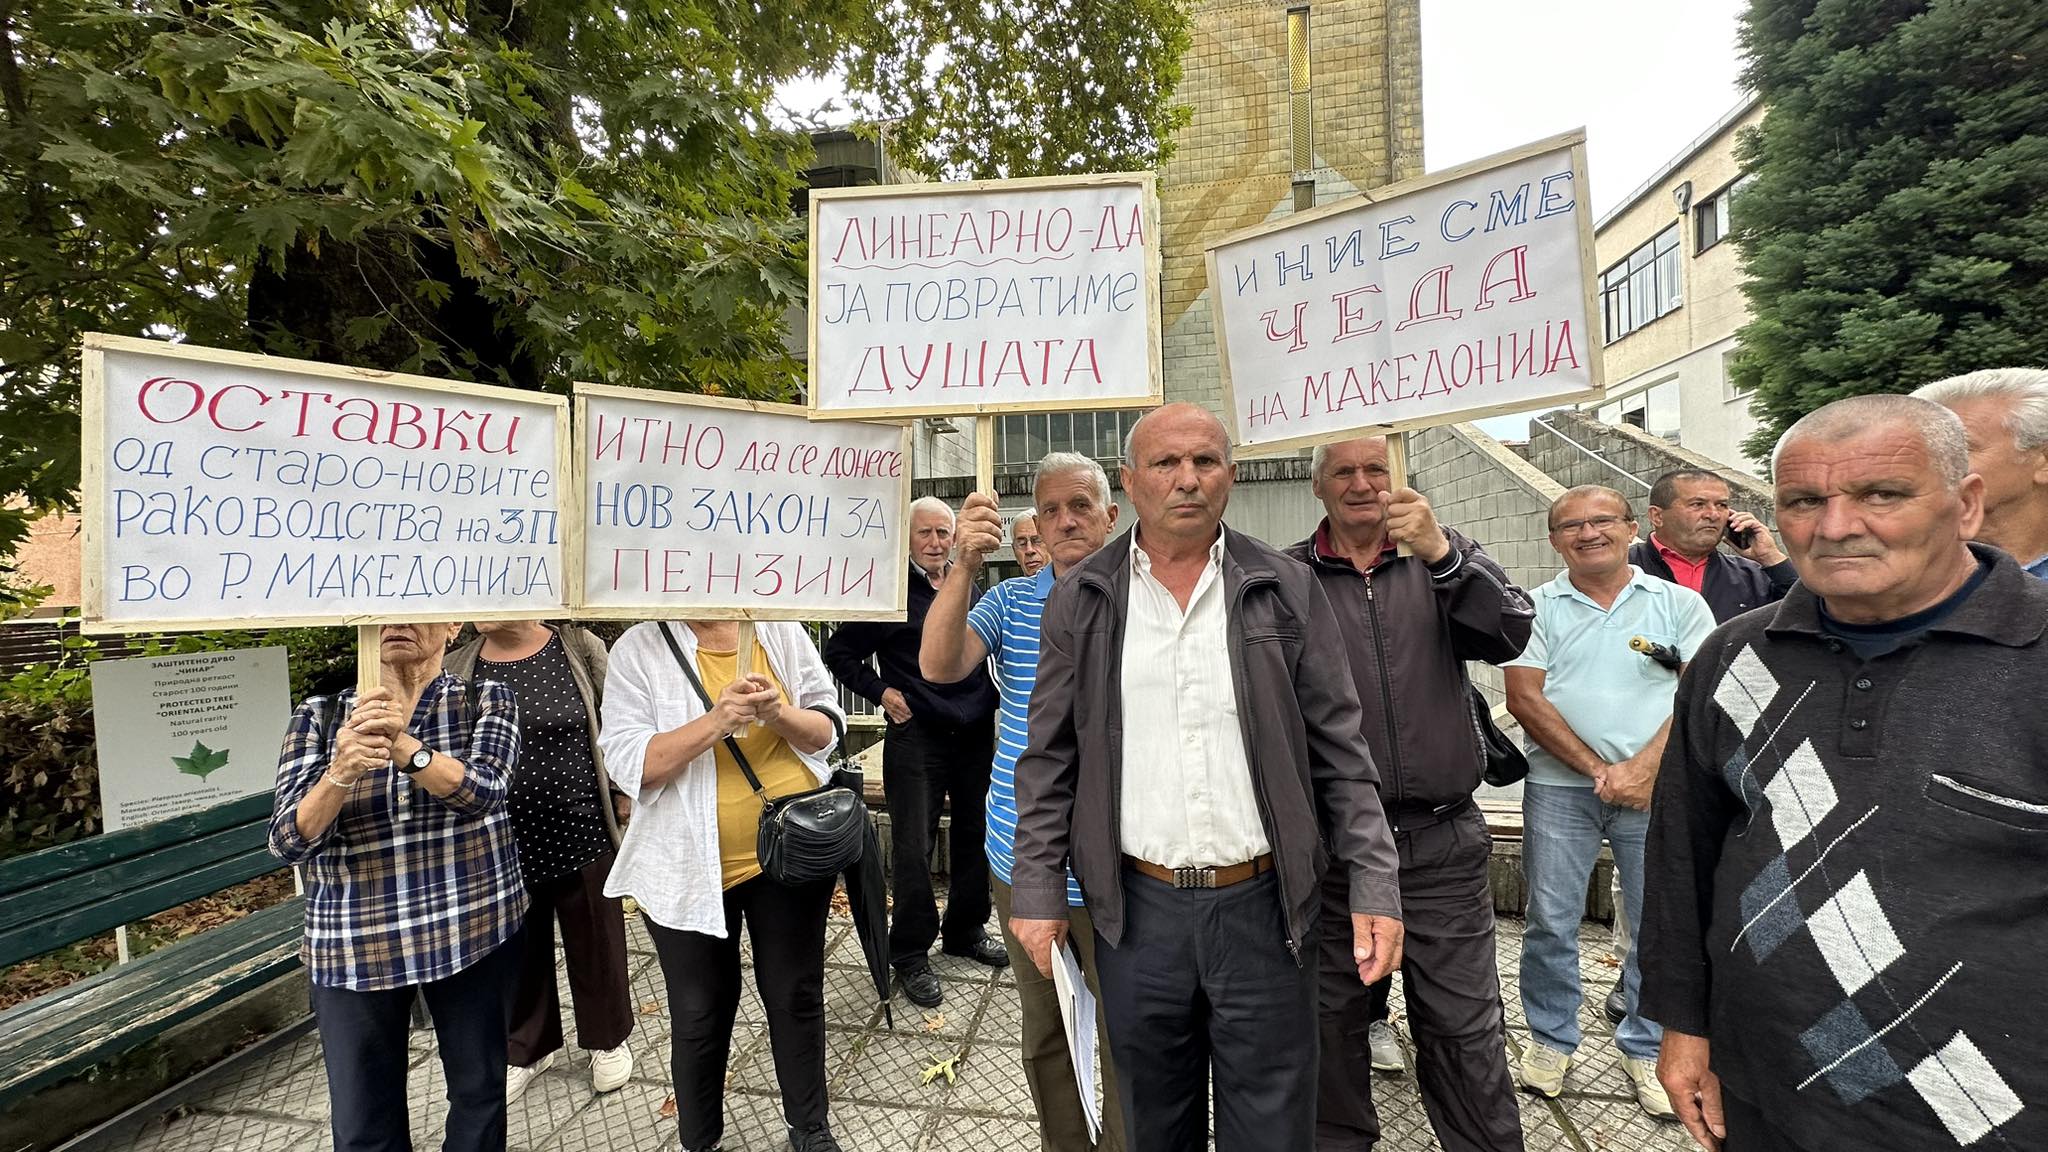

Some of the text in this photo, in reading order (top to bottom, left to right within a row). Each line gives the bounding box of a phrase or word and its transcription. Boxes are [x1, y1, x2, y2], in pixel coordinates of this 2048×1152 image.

[1440, 170, 1576, 243] СМЕ
[825, 283, 871, 324] ЈА
[1259, 244, 1537, 354] ЧЕДА
[848, 338, 1102, 397] ДУШАТА
[1248, 318, 1582, 428] НА МАКЕДОНИЈА
[595, 414, 724, 470] ИТНО
[596, 482, 887, 540] НОВ ЗАКОН ЗА
[219, 552, 253, 600] Р.
[265, 553, 554, 600] МАКЕДОНИЈА
[613, 548, 874, 597] ПЕНЗИИ
[151, 655, 236, 669] ЗАШТИТЕНО ДРВО
[154, 674, 235, 687] Природна реткост
[152, 690, 189, 698] Старост
[160, 695, 234, 709] PROTECTED TREE
[170, 715, 227, 727] Natural rarity
[172, 730, 188, 738] 100
[189, 728, 213, 736] years
